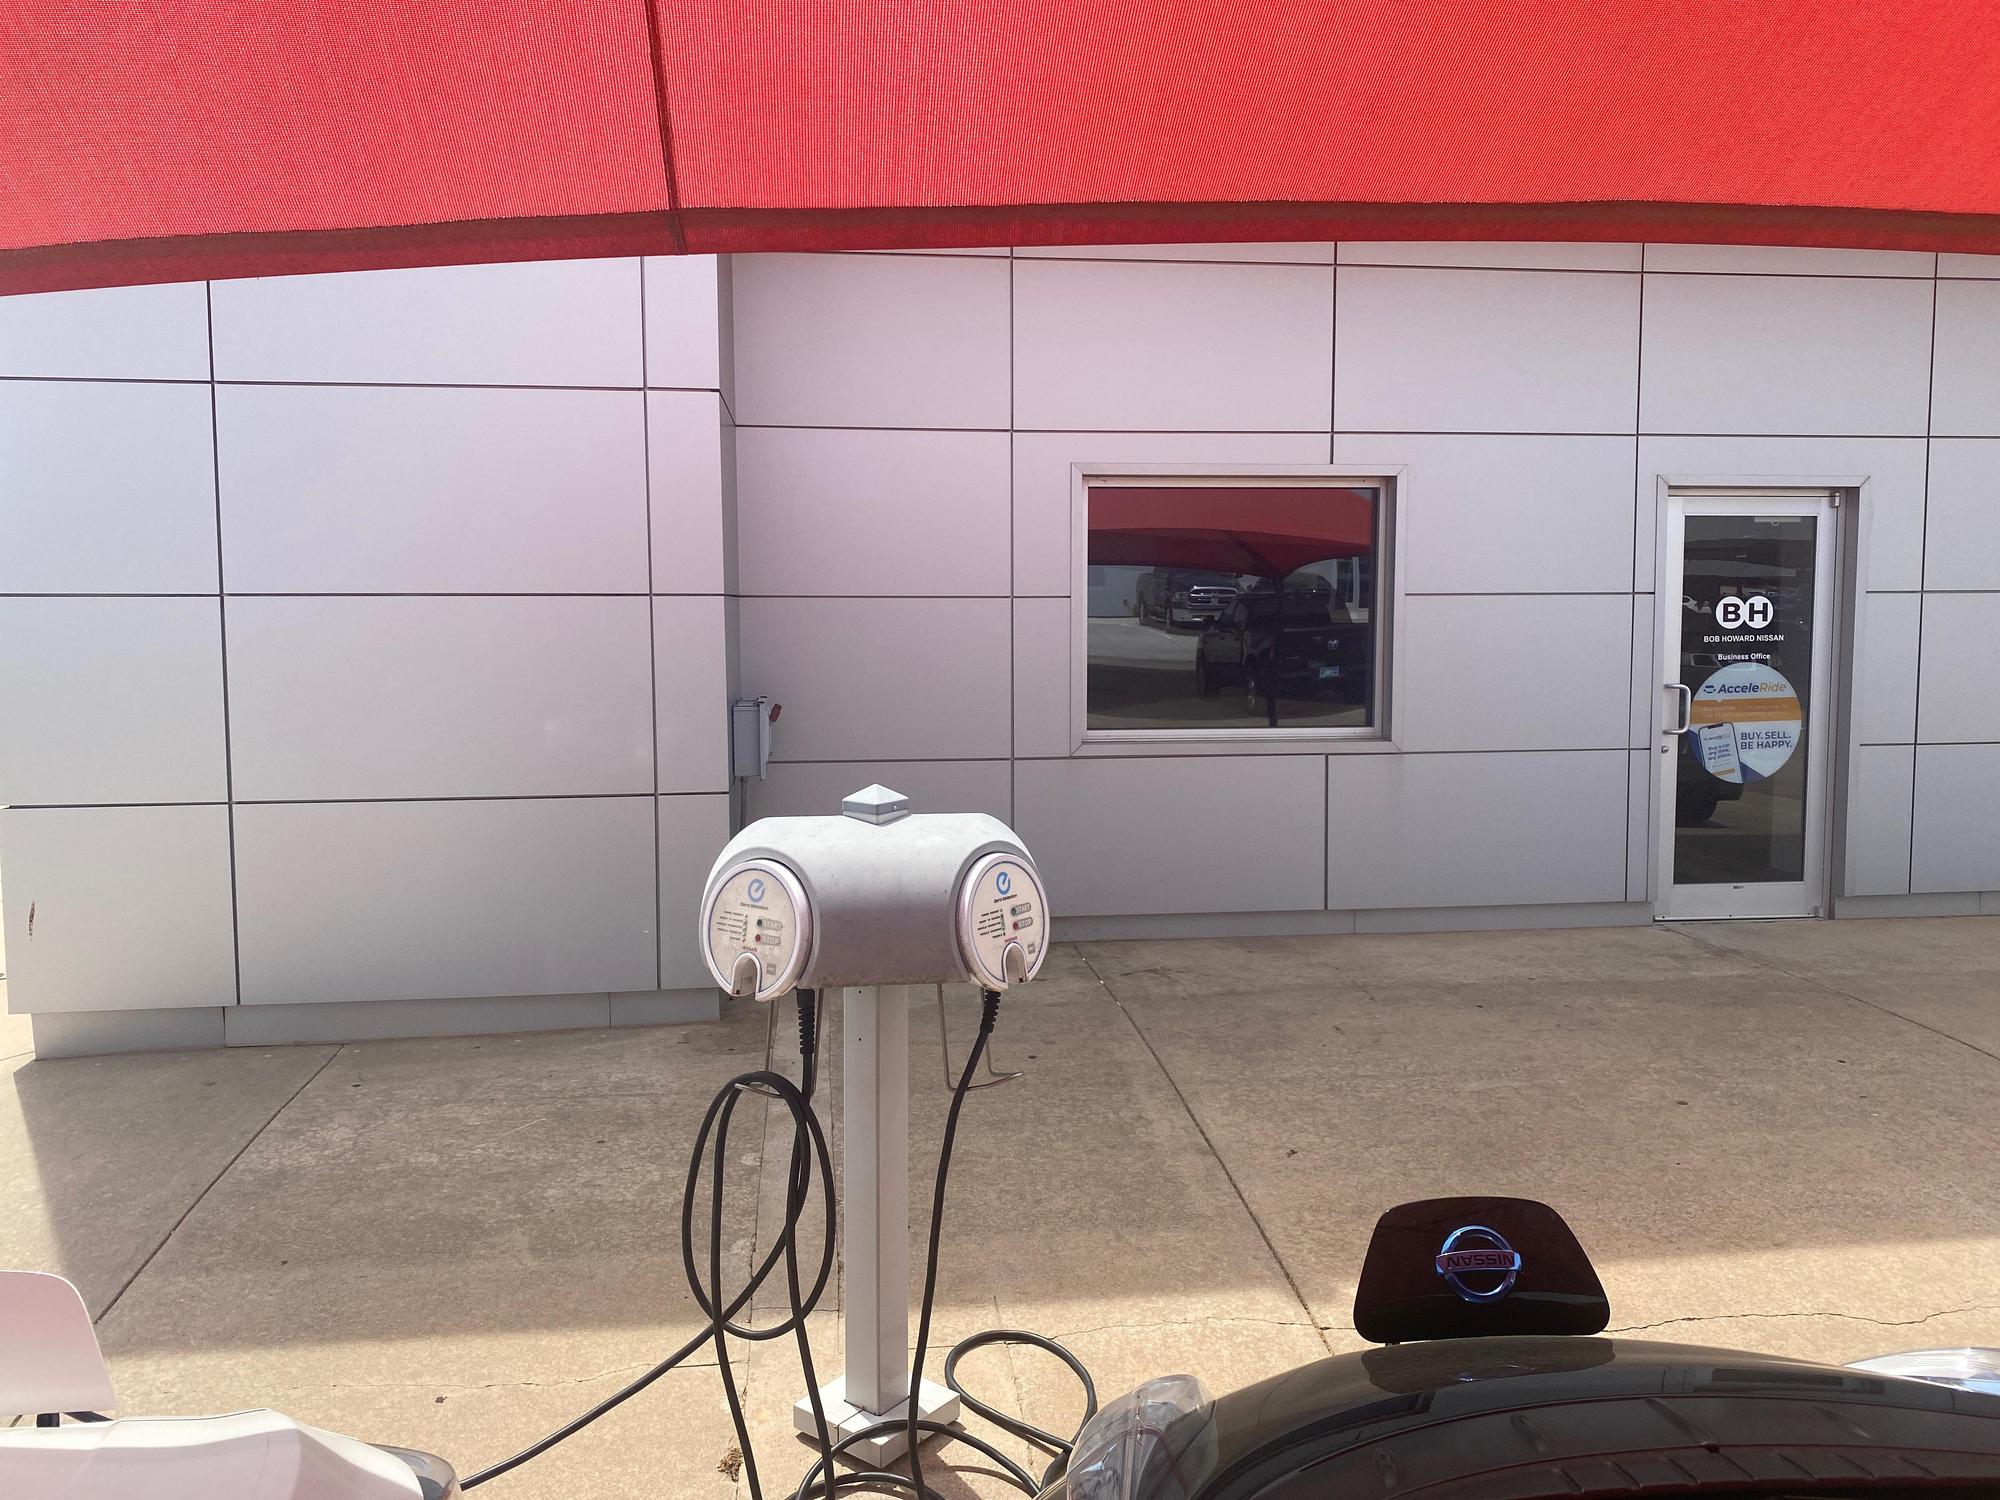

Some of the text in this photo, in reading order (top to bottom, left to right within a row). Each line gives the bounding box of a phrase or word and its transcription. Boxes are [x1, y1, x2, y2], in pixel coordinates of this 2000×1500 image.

[1721, 601, 1769, 623] BH
[1703, 634, 1784, 643] BOB HOWARD NISSAN
[1717, 653, 1749, 661] Business
[1717, 681, 1787, 694] AcceleRide
[1740, 731, 1763, 740] BUY.
[1765, 730, 1791, 740] SELL.
[1740, 740, 1792, 750] BE HAPPY.
[1017, 904, 1031, 913] START
[1019, 919, 1032, 927] STOP
[1446, 1252, 1513, 1268] NISSAN
